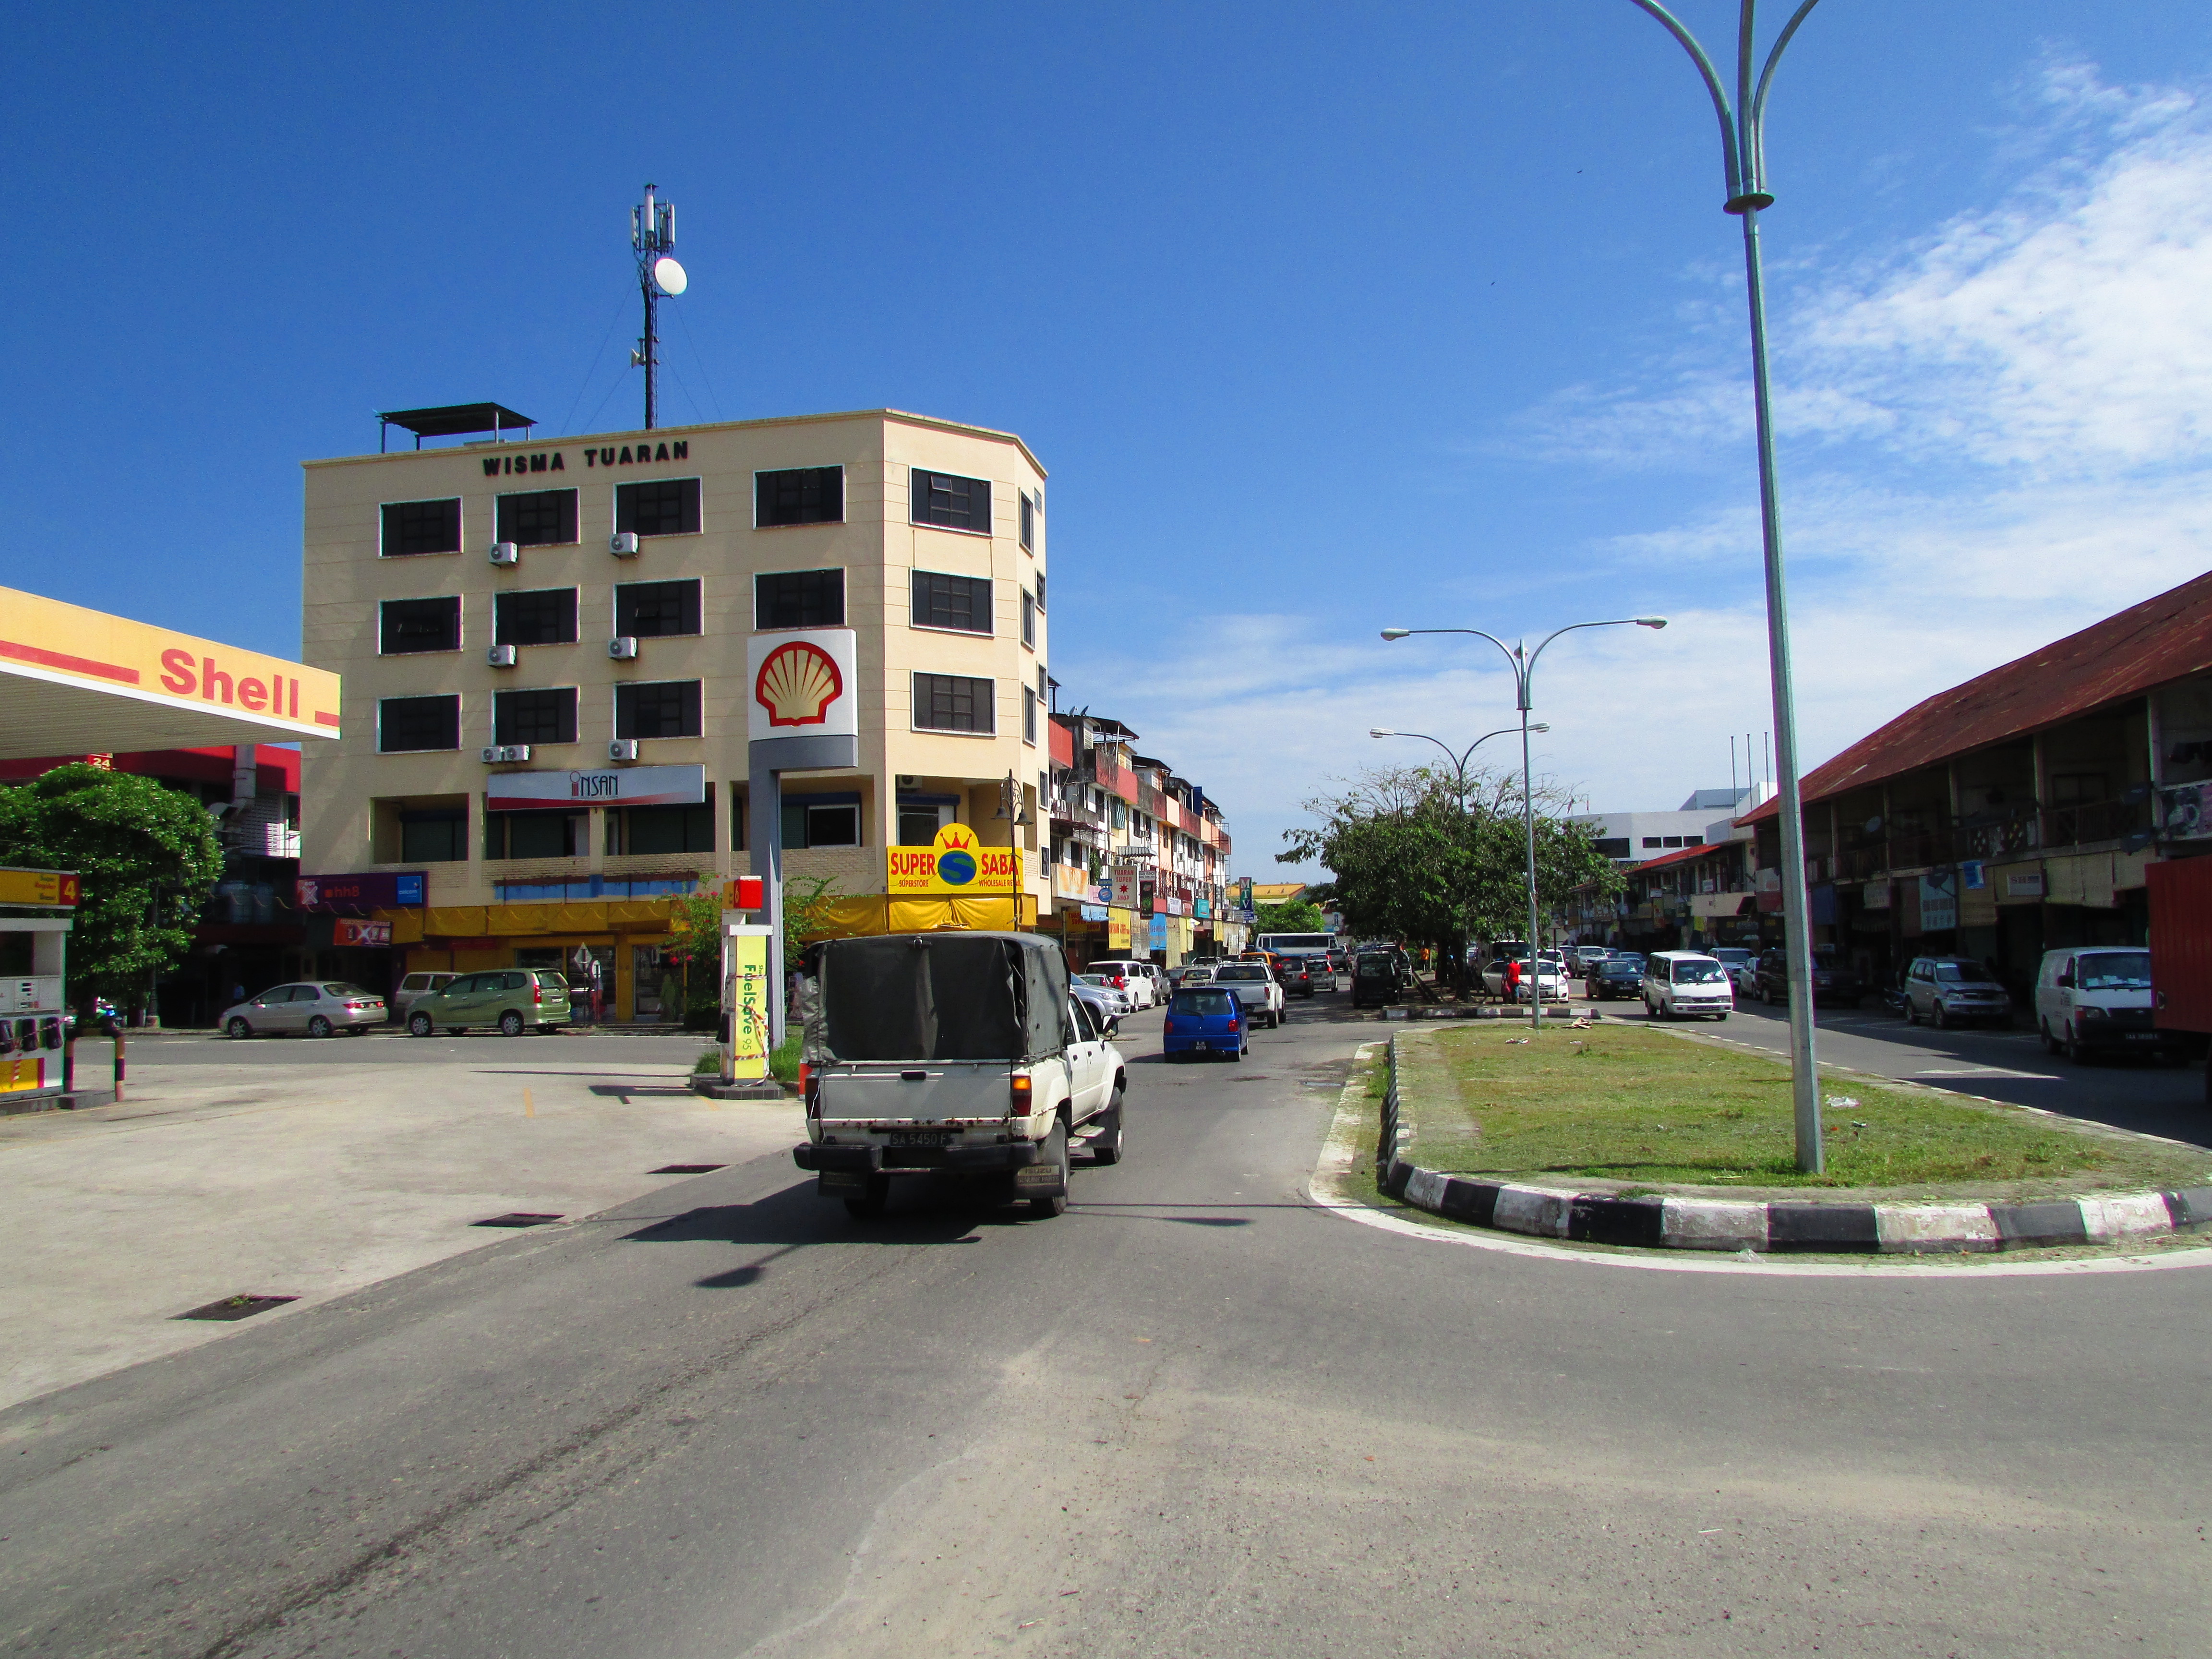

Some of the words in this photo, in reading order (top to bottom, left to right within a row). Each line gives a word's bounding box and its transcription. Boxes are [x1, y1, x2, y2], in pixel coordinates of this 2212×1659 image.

[482, 452, 565, 477] WISMA
[584, 440, 689, 468] TUARAN
[160, 649, 299, 718] Shell
[93, 758, 111, 767] 24
[891, 853, 936, 875] SUPER
[981, 854, 1019, 875] SABA
[64, 880, 76, 900] 4
[735, 885, 740, 903] 6
[743, 1038, 752, 1050] 95
[892, 1134, 906, 1144] SA
[909, 1133, 937, 1144] 5450
